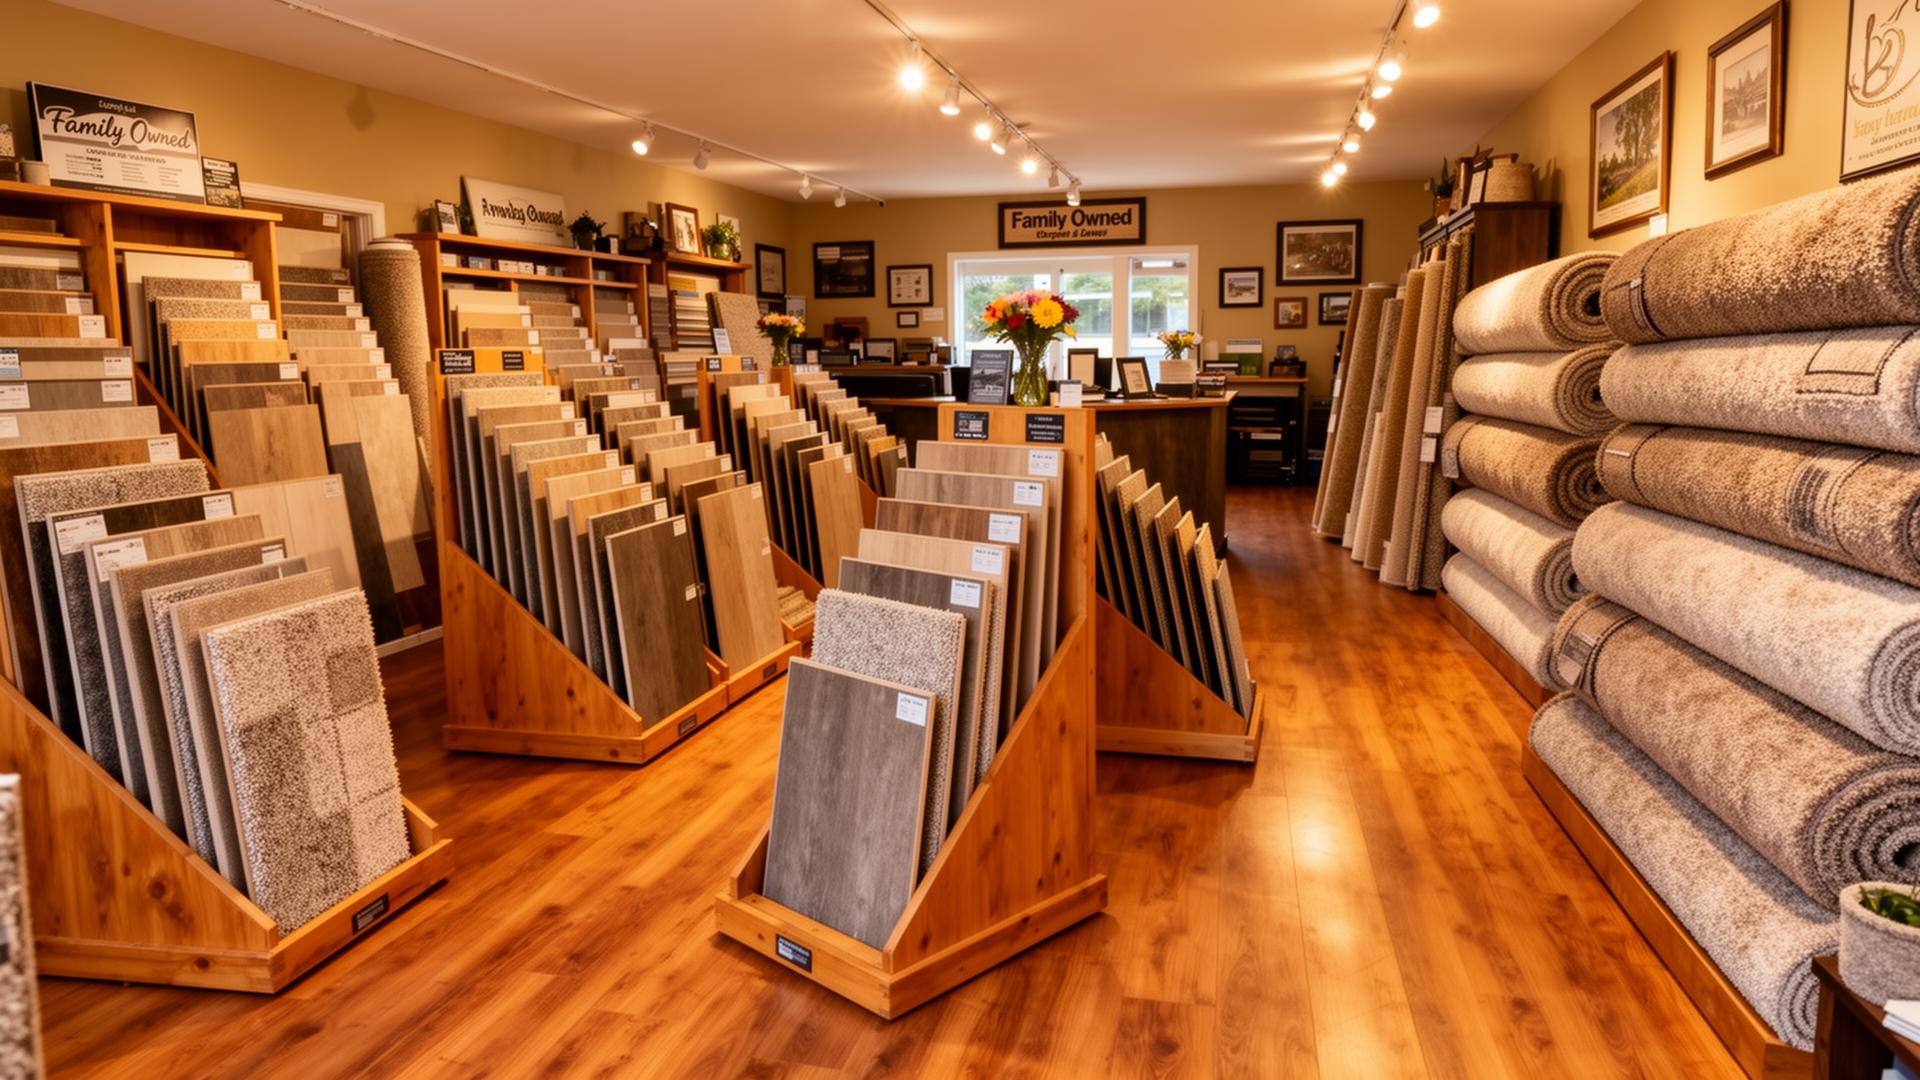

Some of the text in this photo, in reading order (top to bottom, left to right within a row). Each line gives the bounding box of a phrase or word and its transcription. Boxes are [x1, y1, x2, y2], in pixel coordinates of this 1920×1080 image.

[46, 107, 190, 149] Family Owned
[1012, 208, 1132, 230] Family Owned
